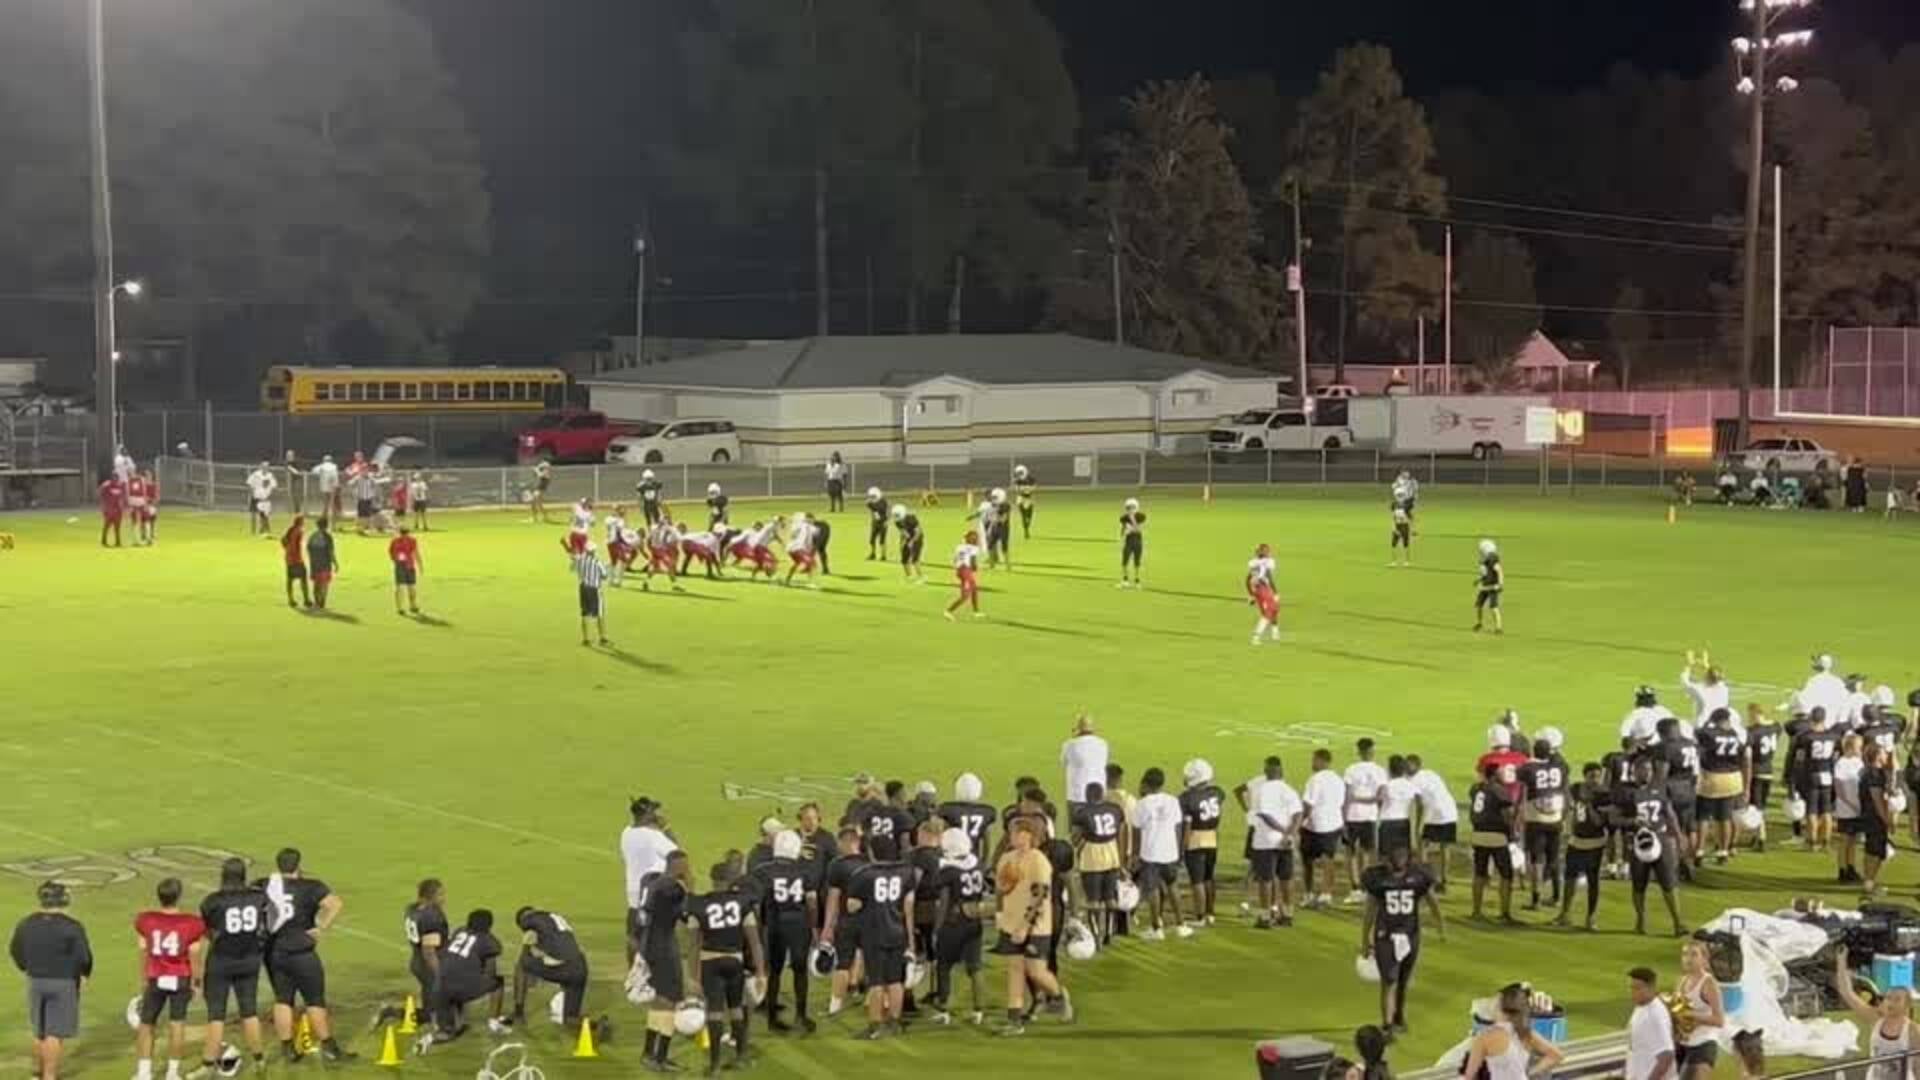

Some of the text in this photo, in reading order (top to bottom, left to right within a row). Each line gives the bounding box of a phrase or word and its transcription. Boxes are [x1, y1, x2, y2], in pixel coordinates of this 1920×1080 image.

[1714, 736, 1739, 756] 77
[1536, 767, 1562, 789] 29
[1473, 790, 1485, 813] 6
[1637, 800, 1662, 823] 57
[960, 815, 984, 837] 17
[1093, 813, 1117, 836] 12
[773, 877, 802, 903] 54
[1385, 889, 1414, 915] 55
[224, 905, 258, 934] 69
[705, 900, 741, 929] 23
[150, 929, 179, 957] 14
[447, 932, 476, 959] 21
